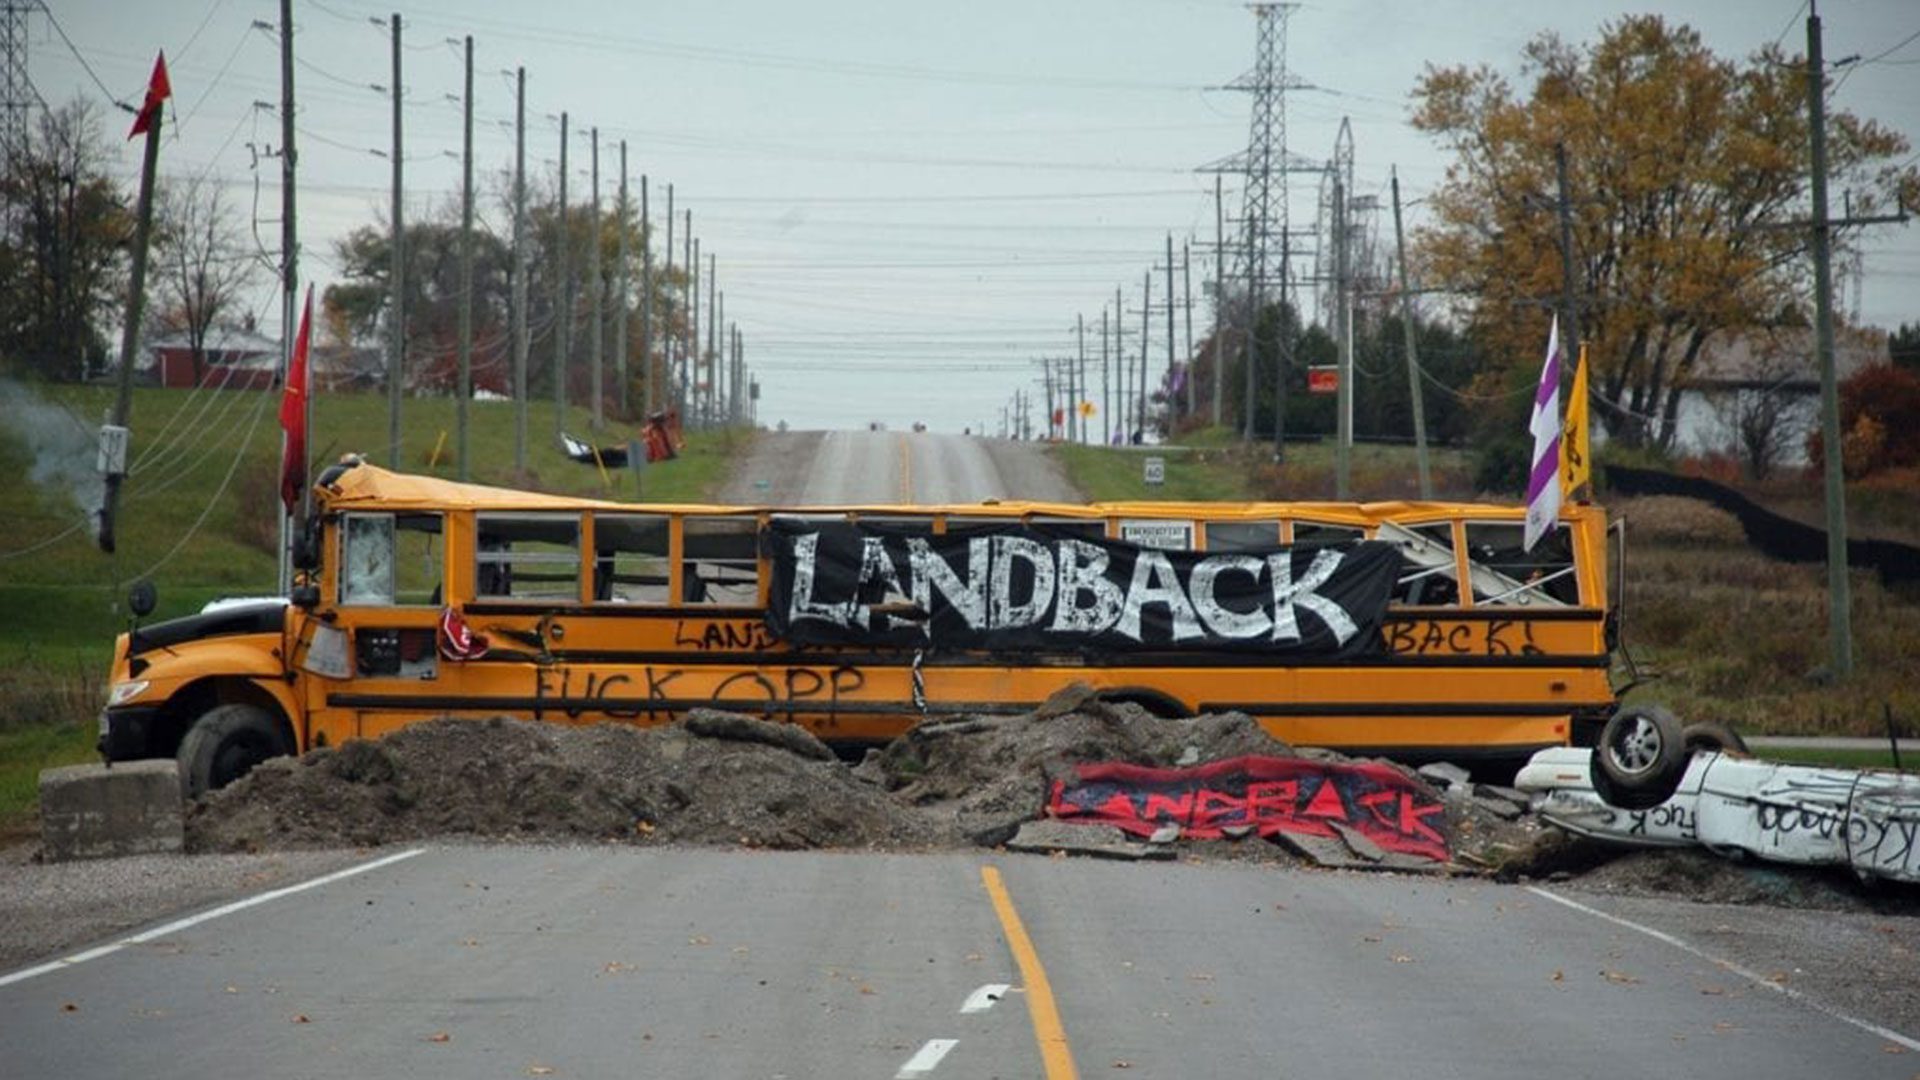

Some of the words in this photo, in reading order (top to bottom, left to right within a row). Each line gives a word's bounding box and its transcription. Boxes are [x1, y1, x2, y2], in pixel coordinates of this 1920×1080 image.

[788, 532, 1361, 647] LANDBACK
[535, 667, 683, 721] FUCK
[711, 666, 866, 726] OPP
